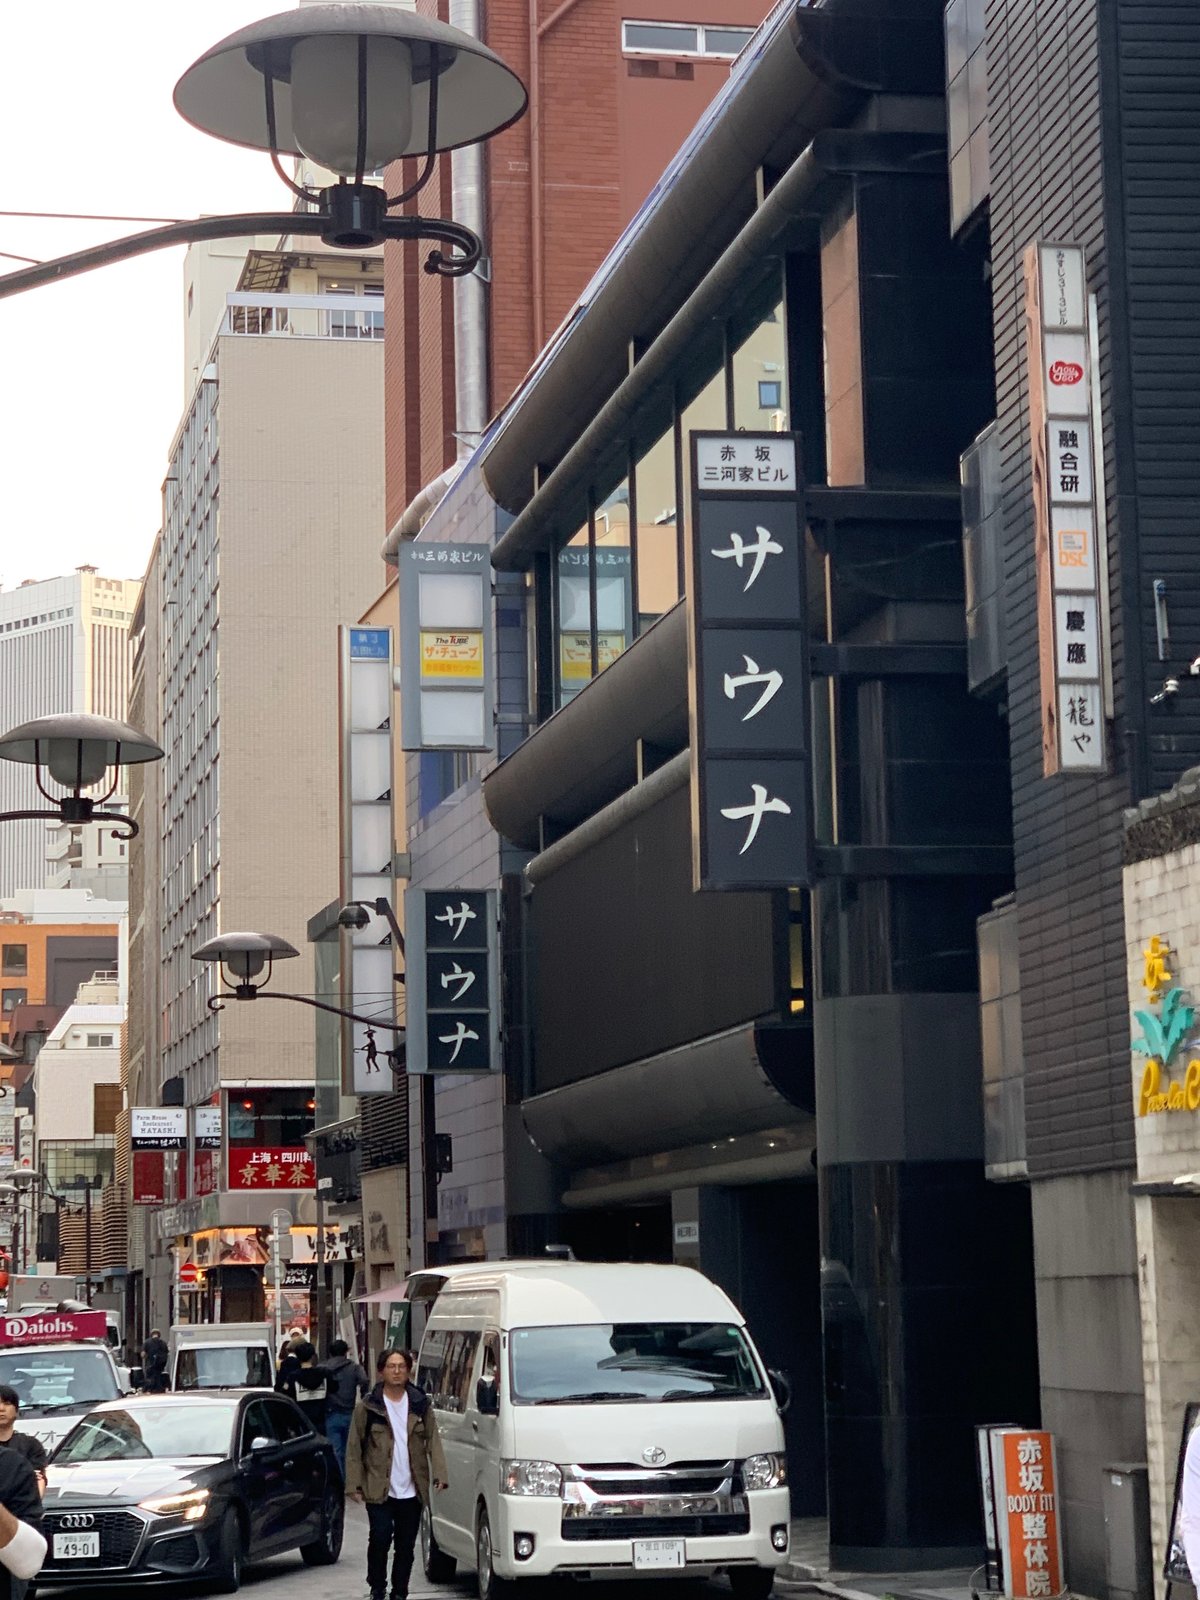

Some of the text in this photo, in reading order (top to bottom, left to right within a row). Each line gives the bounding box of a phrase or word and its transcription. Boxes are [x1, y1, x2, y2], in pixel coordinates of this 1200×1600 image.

[720, 445, 771, 462] 赤坂
[1058, 430, 1080, 494] 融合研
[704, 466, 789, 482] 三河家ビル
[710, 526, 792, 856] サウナ
[434, 901, 479, 1064] サウナ
[239, 1164, 316, 1186] 京華茶
[5, 1317, 75, 1337] Daiohs
[1018, 1438, 1045, 1492] 赤坂
[1007, 1495, 1036, 1513] BODY
[63, 1542, 95, 1556] 49-01
[1022, 1514, 1051, 1597] 整体院
